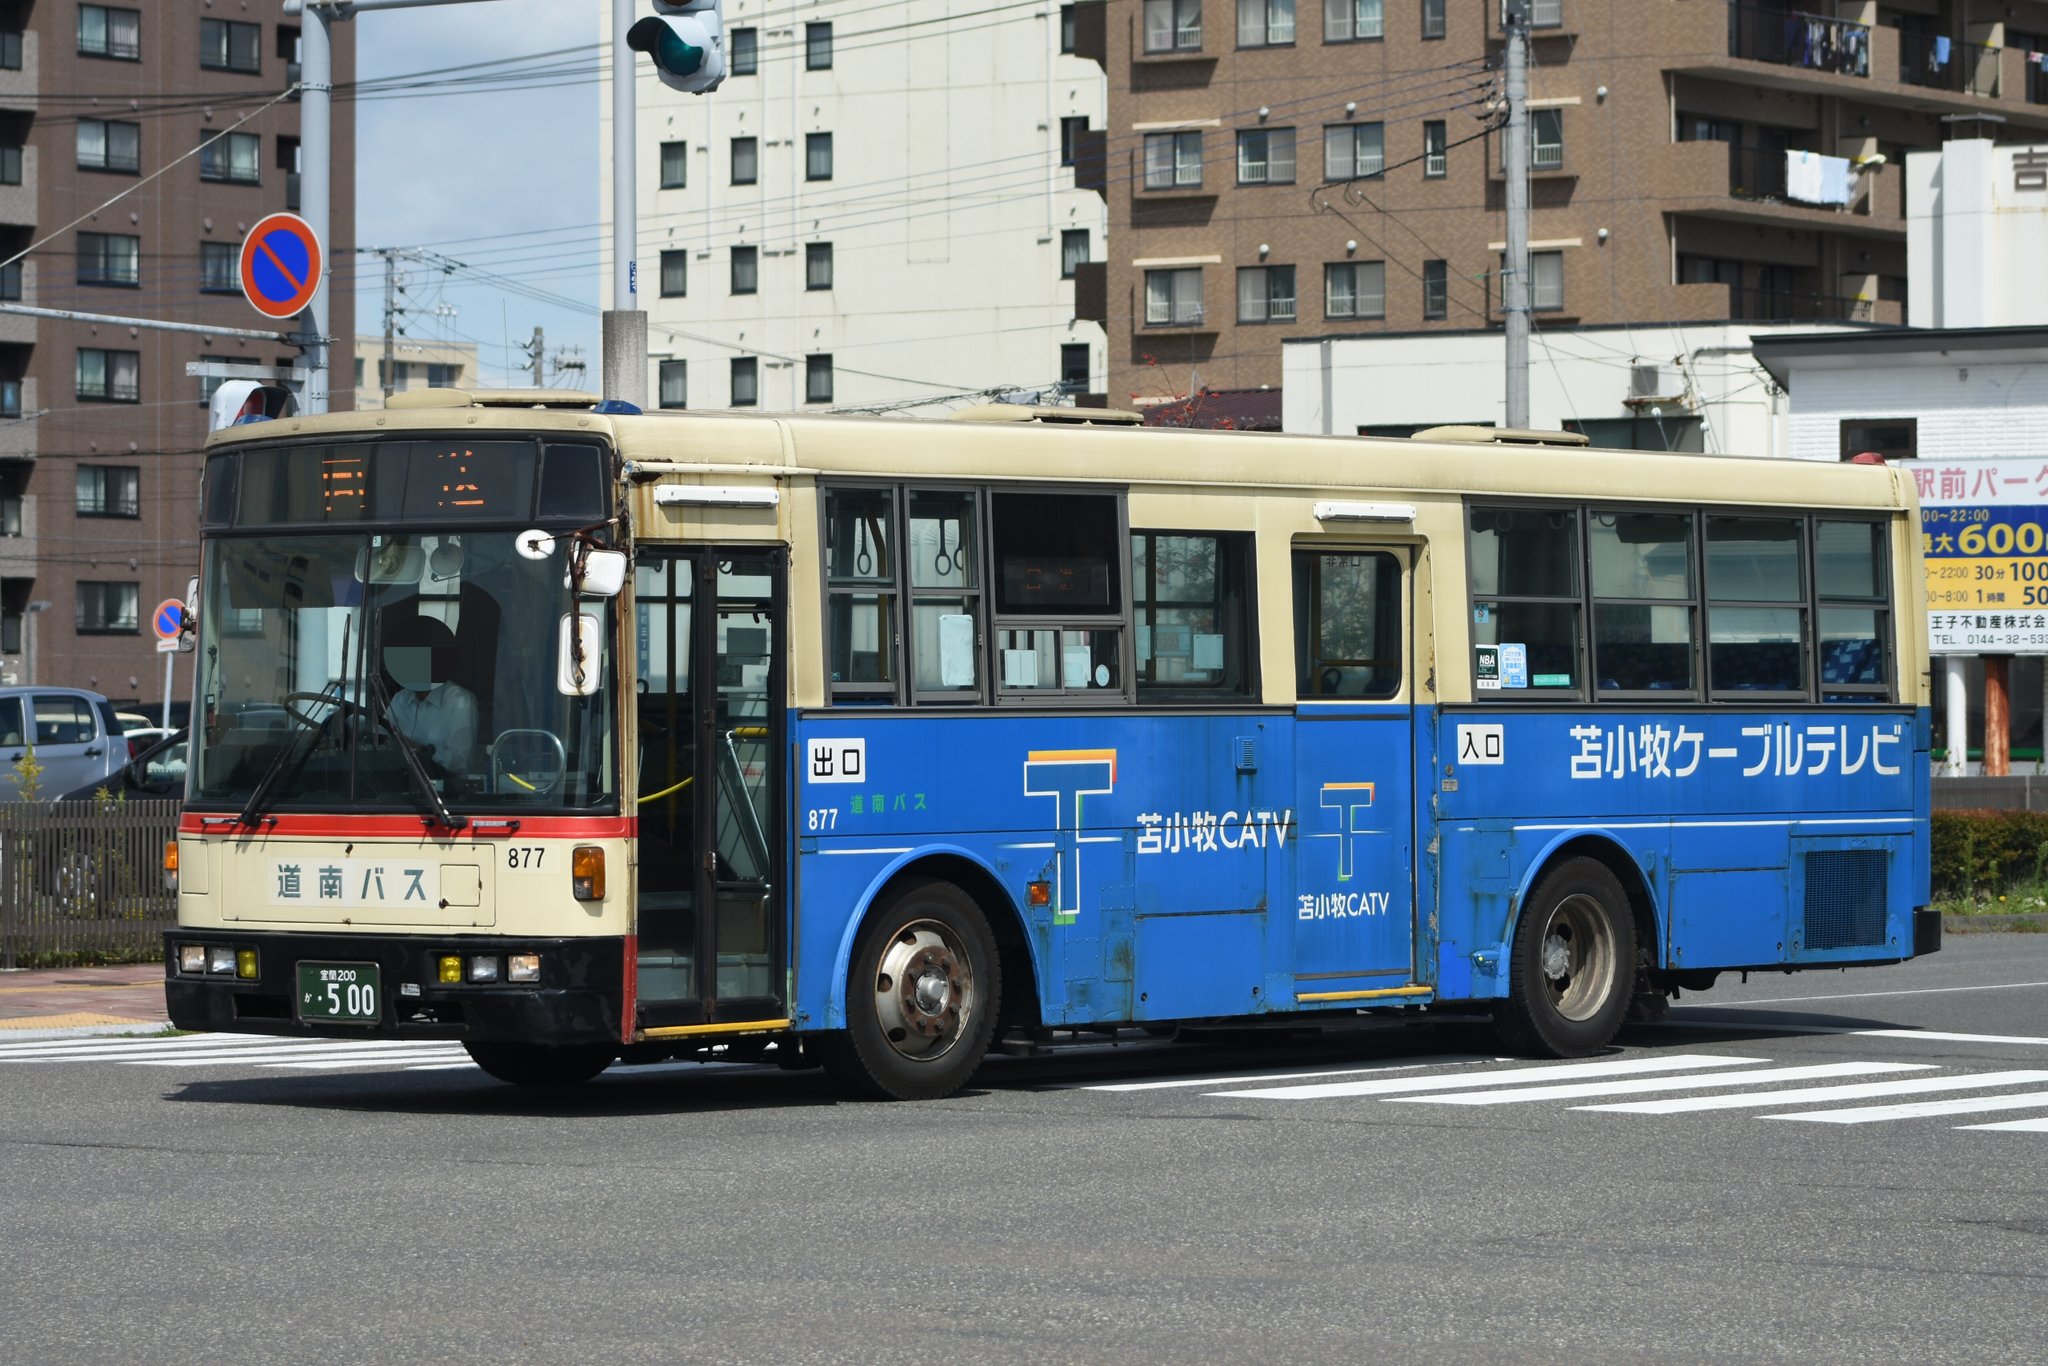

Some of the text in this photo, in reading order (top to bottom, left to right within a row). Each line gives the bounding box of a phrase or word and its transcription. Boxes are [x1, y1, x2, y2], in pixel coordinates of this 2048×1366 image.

[1931, 615, 2045, 629] 王子不動産株式会
[1480, 655, 1495, 665] NBA
[1463, 731, 1499, 759] 入口
[1570, 724, 1902, 779] 苫小牧ケーブルテレビ
[814, 746, 860, 776] 出口
[851, 792, 927, 814] 道南バス
[808, 808, 838, 830] 877
[1137, 809, 1291, 853] 苫小牧CATV
[508, 848, 545, 868] 877
[278, 864, 427, 900] 道南バス
[1298, 892, 1389, 920] 苫小牧CATV
[304, 993, 312, 1004] か
